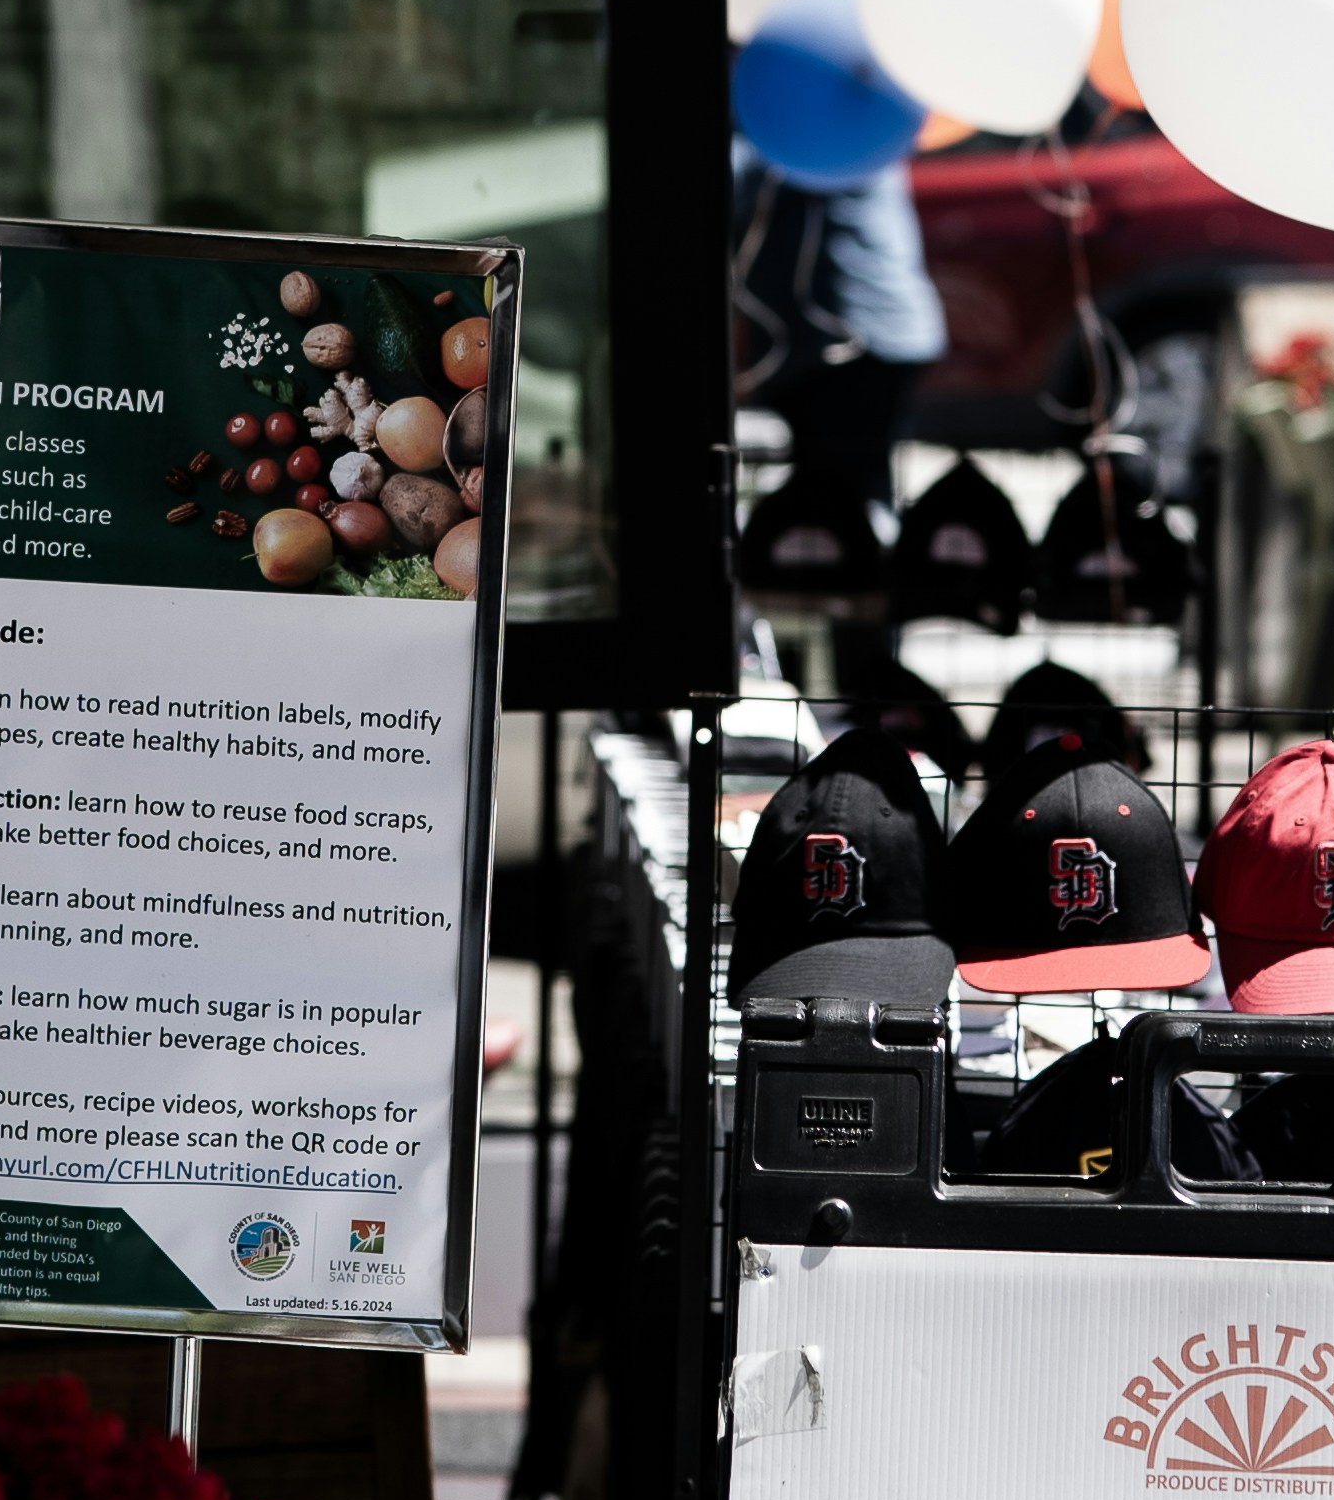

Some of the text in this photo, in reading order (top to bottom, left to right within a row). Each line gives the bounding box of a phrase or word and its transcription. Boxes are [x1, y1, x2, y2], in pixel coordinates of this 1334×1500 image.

[13, 382, 164, 413] PROGRAM
[6, 430, 85, 454] classes
[2, 466, 54, 487] such
[63, 473, 86, 489] as
[25, 541, 91, 558] more.
[20, 688, 70, 711] how
[77, 694, 100, 713] to
[109, 695, 159, 716] read
[169, 700, 269, 721] nutrition
[279, 702, 351, 729] labels,
[361, 709, 441, 735] modify
[69, 790, 126, 814] learn
[135, 794, 185, 816] how
[192, 800, 215, 818] to
[224, 805, 286, 822] reuse
[294, 803, 347, 825] food
[354, 812, 433, 833] scraps,
[1, 884, 58, 907] learn
[67, 888, 135, 911] about
[144, 893, 284, 918] mindfulness
[292, 901, 335, 921] and
[344, 905, 451, 931] nutrition,
[80, 924, 123, 944] and
[132, 931, 198, 948] more.
[12, 985, 69, 1008] learn
[79, 988, 128, 1011] how
[136, 994, 199, 1014] much
[207, 1001, 271, 1021] sugar
[279, 999, 294, 1019] is
[303, 1000, 322, 1020] in
[331, 1004, 421, 1028] popular
[84, 1092, 155, 1117] recipe
[163, 1094, 242, 1118] videos,
[252, 1096, 376, 1125] workshops
[384, 1101, 417, 1123] for
[37, 1127, 97, 1144] more
[106, 1125, 179, 1150] please
[187, 1132, 237, 1148] scan
[245, 1128, 283, 1150] the
[292, 1132, 325, 1154] QR
[333, 1135, 388, 1154] code
[396, 1141, 421, 1156] or
[0, 1212, 43, 1227] County
[46, 1216, 58, 1226] of
[62, 1217, 83, 1229] San
[87, 1219, 122, 1233] Diego
[329, 1272, 405, 1285] SAN DIEGO
[330, 1260, 405, 1274] LIVE WELL
[246, 1296, 392, 1312] Last updated: 5.16.2024
[1146, 1474, 1228, 1491] PRODUCE
